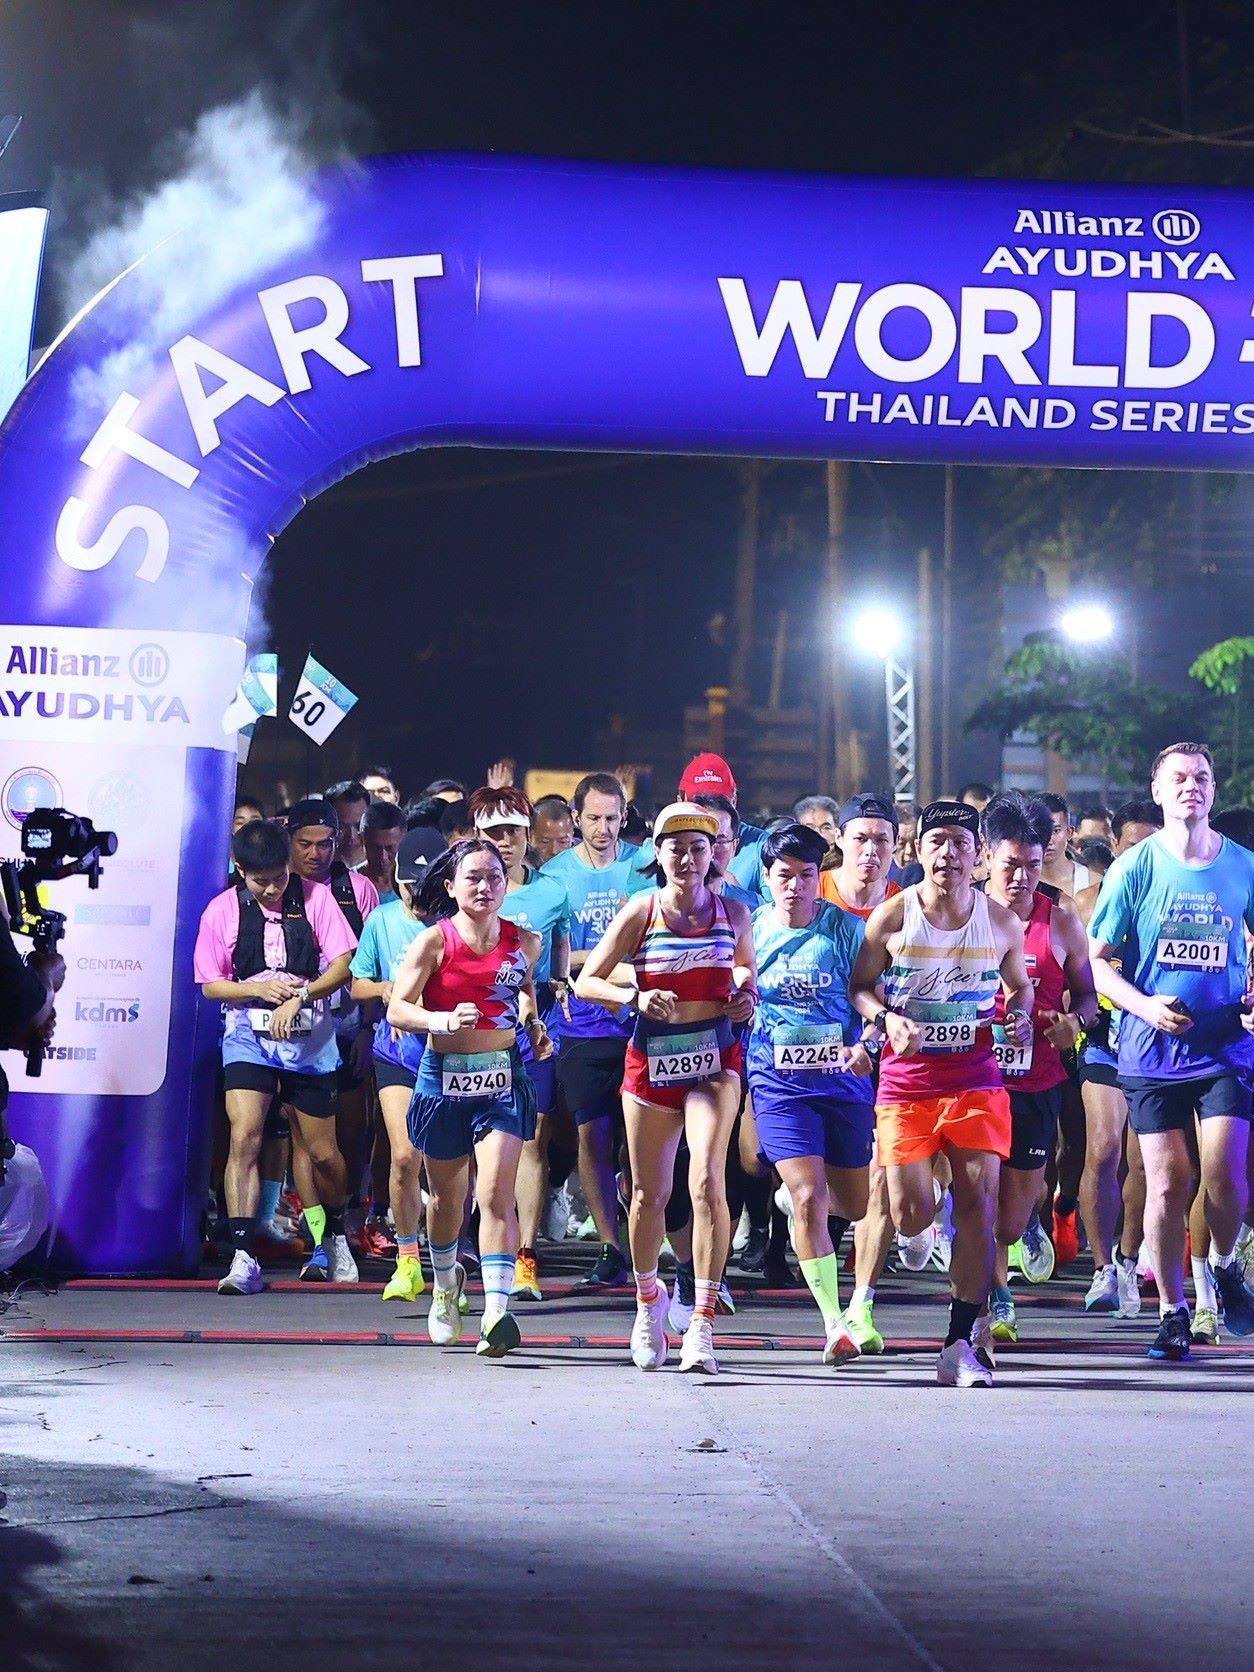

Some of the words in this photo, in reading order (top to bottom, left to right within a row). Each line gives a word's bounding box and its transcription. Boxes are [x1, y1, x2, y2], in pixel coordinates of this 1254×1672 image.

[1014, 208, 1144, 237] Allianz
[981, 245, 1236, 281] AYUDHYA
[717, 276, 1217, 390] WORLD
[55, 253, 443, 583] START
[815, 391, 1080, 431] THAILAND
[6, 645, 121, 677] Allianz
[1163, 942, 1220, 962] A2001
[77, 957, 143, 971] CENTARA
[762, 972, 833, 989] WORLD
[74, 1002, 140, 1023] kdms
[924, 1024, 970, 1042] 2898
[655, 1053, 715, 1076] A2899
[781, 1046, 839, 1065] A2245
[448, 1073, 507, 1092] A2940
